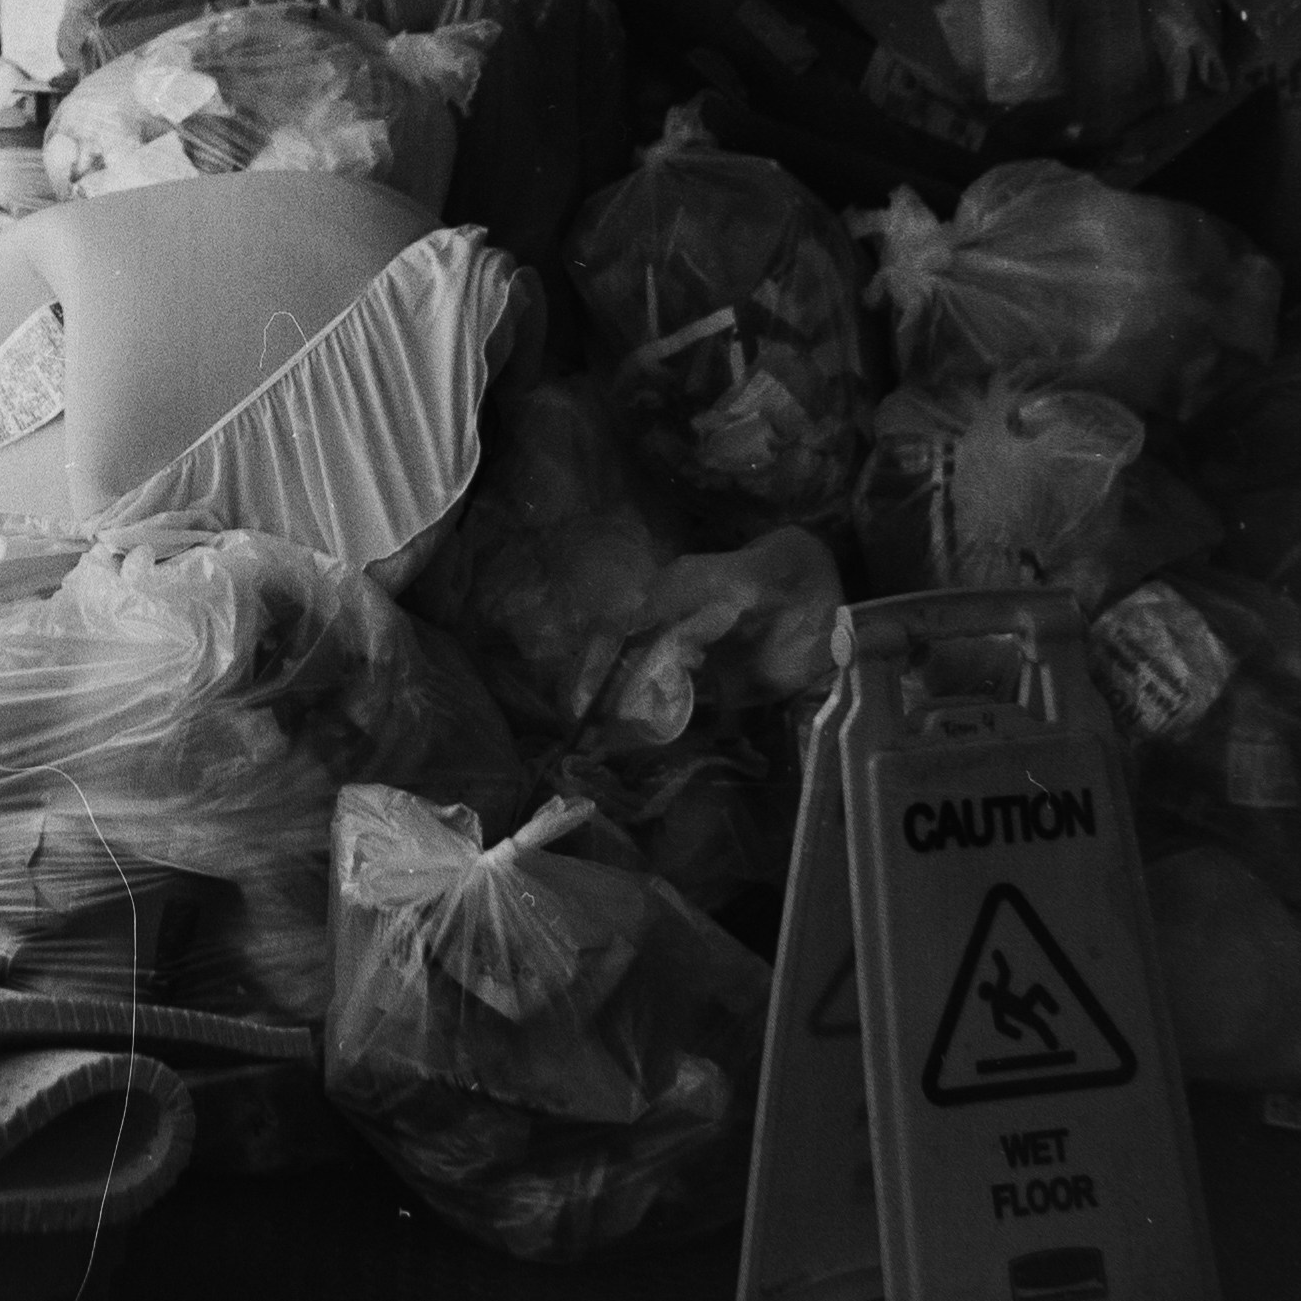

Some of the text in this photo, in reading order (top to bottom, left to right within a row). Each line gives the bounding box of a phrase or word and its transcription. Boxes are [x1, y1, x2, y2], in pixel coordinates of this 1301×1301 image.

[903, 788, 1096, 853] CAUTION
[1000, 1128, 1070, 1169] WET
[991, 1174, 1099, 1220] FLOOR
